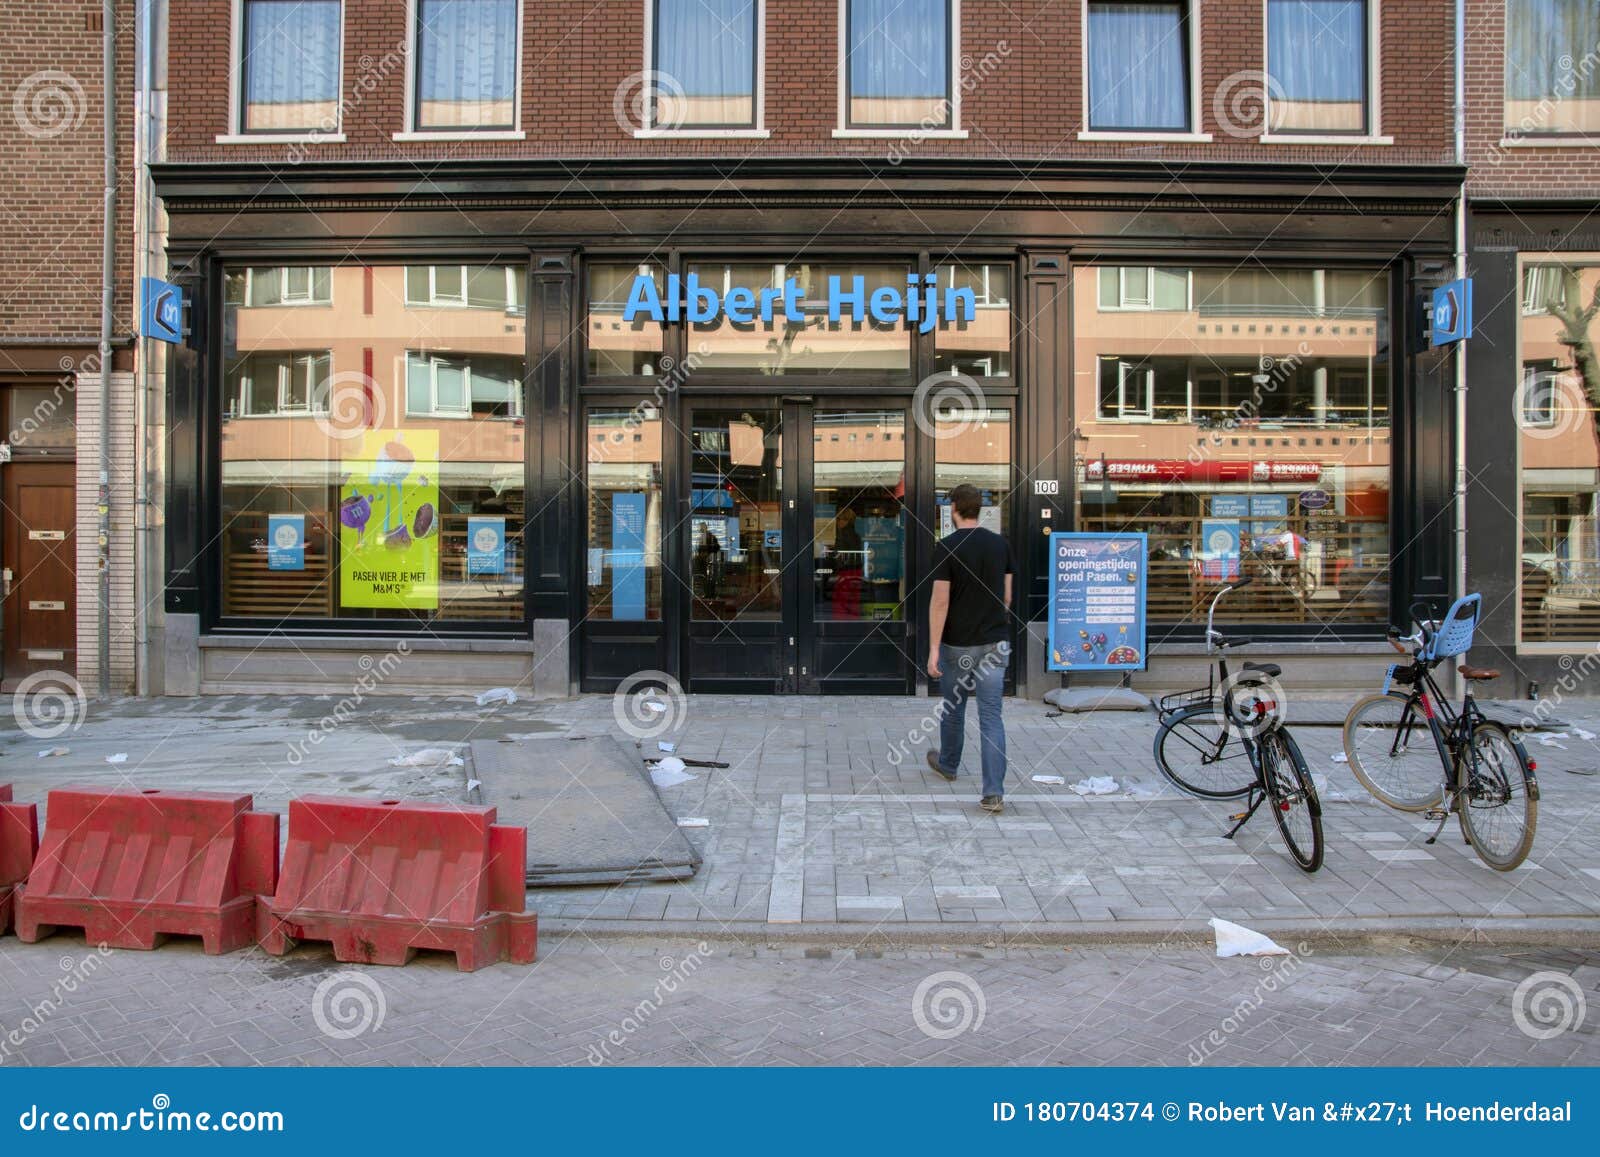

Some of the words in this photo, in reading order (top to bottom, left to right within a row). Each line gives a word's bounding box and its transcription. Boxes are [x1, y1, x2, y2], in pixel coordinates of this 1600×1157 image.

[622, 273, 805, 322] Albert
[828, 273, 976, 334] Heijn
[1036, 481, 1057, 493] 100
[1058, 546, 1087, 557] Onze
[1058, 558, 1137, 571] openingstijden
[353, 571, 378, 581] PASEN
[379, 571, 397, 582] VIER
[399, 572, 408, 582] JE
[410, 572, 426, 582] MET
[1058, 571, 1084, 581] rond
[1086, 571, 1122, 581] Pasen.
